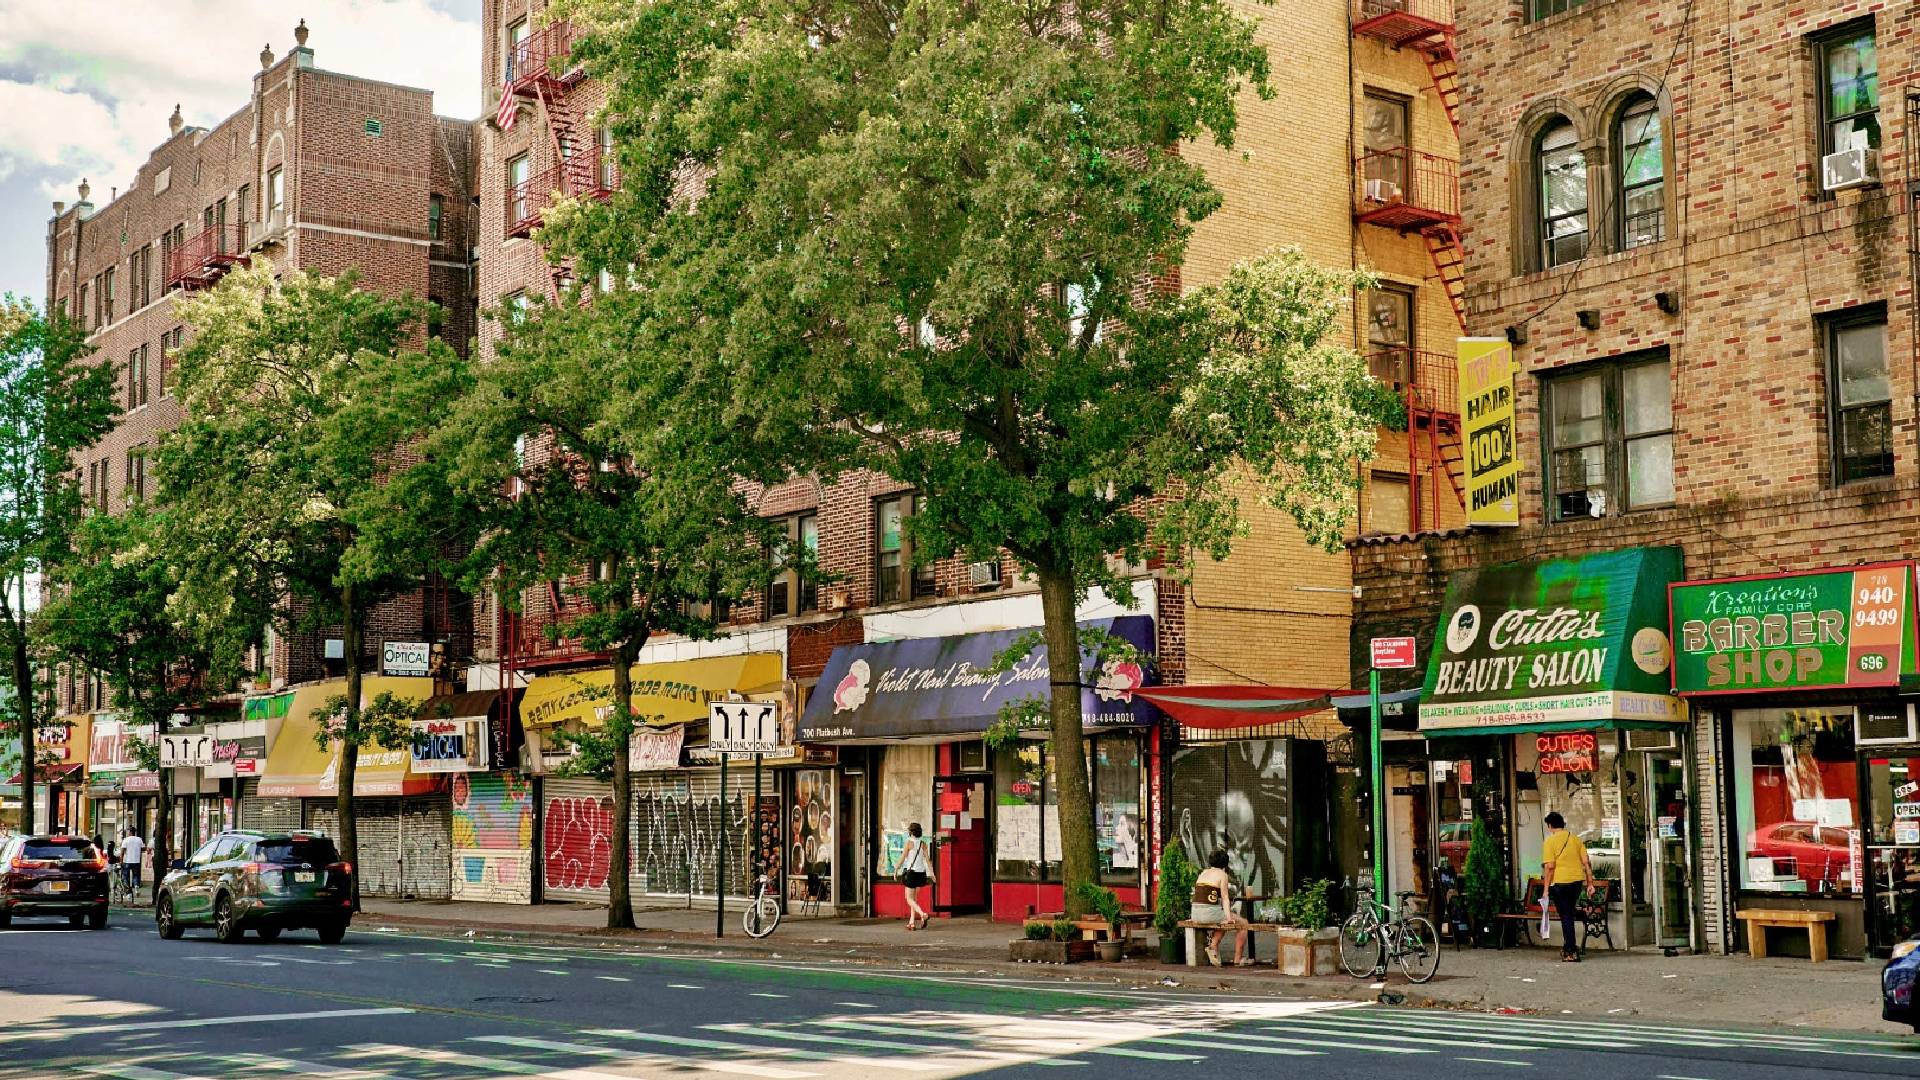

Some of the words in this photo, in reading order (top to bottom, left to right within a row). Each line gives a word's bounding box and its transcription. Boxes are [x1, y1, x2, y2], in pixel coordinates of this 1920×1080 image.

[1467, 386, 1511, 421] HAIR
[1472, 425, 1512, 474] 100%
[1473, 473, 1516, 512] HUMAN
[1726, 604, 1771, 615] FAMILY
[1855, 608, 1898, 627] 9499
[1488, 607, 1605, 651] Cutie's
[1682, 609, 1847, 654] BARBER
[384, 648, 428, 665] OPTICAL
[1861, 654, 1884, 670] 696
[1434, 656, 1524, 696] BEAUTY
[1529, 648, 1608, 689] SALON
[1706, 648, 1824, 687] SHOP
[876, 667, 919, 694] Violet
[915, 662, 957, 690] Nail
[711, 740, 731, 749] ONLY
[733, 740, 752, 750] ONLY
[755, 740, 775, 750] ONLY
[1536, 734, 1594, 752] CUTIE'S
[1540, 756, 1593, 773] SALON
[1012, 783, 1032, 793] OPEN
